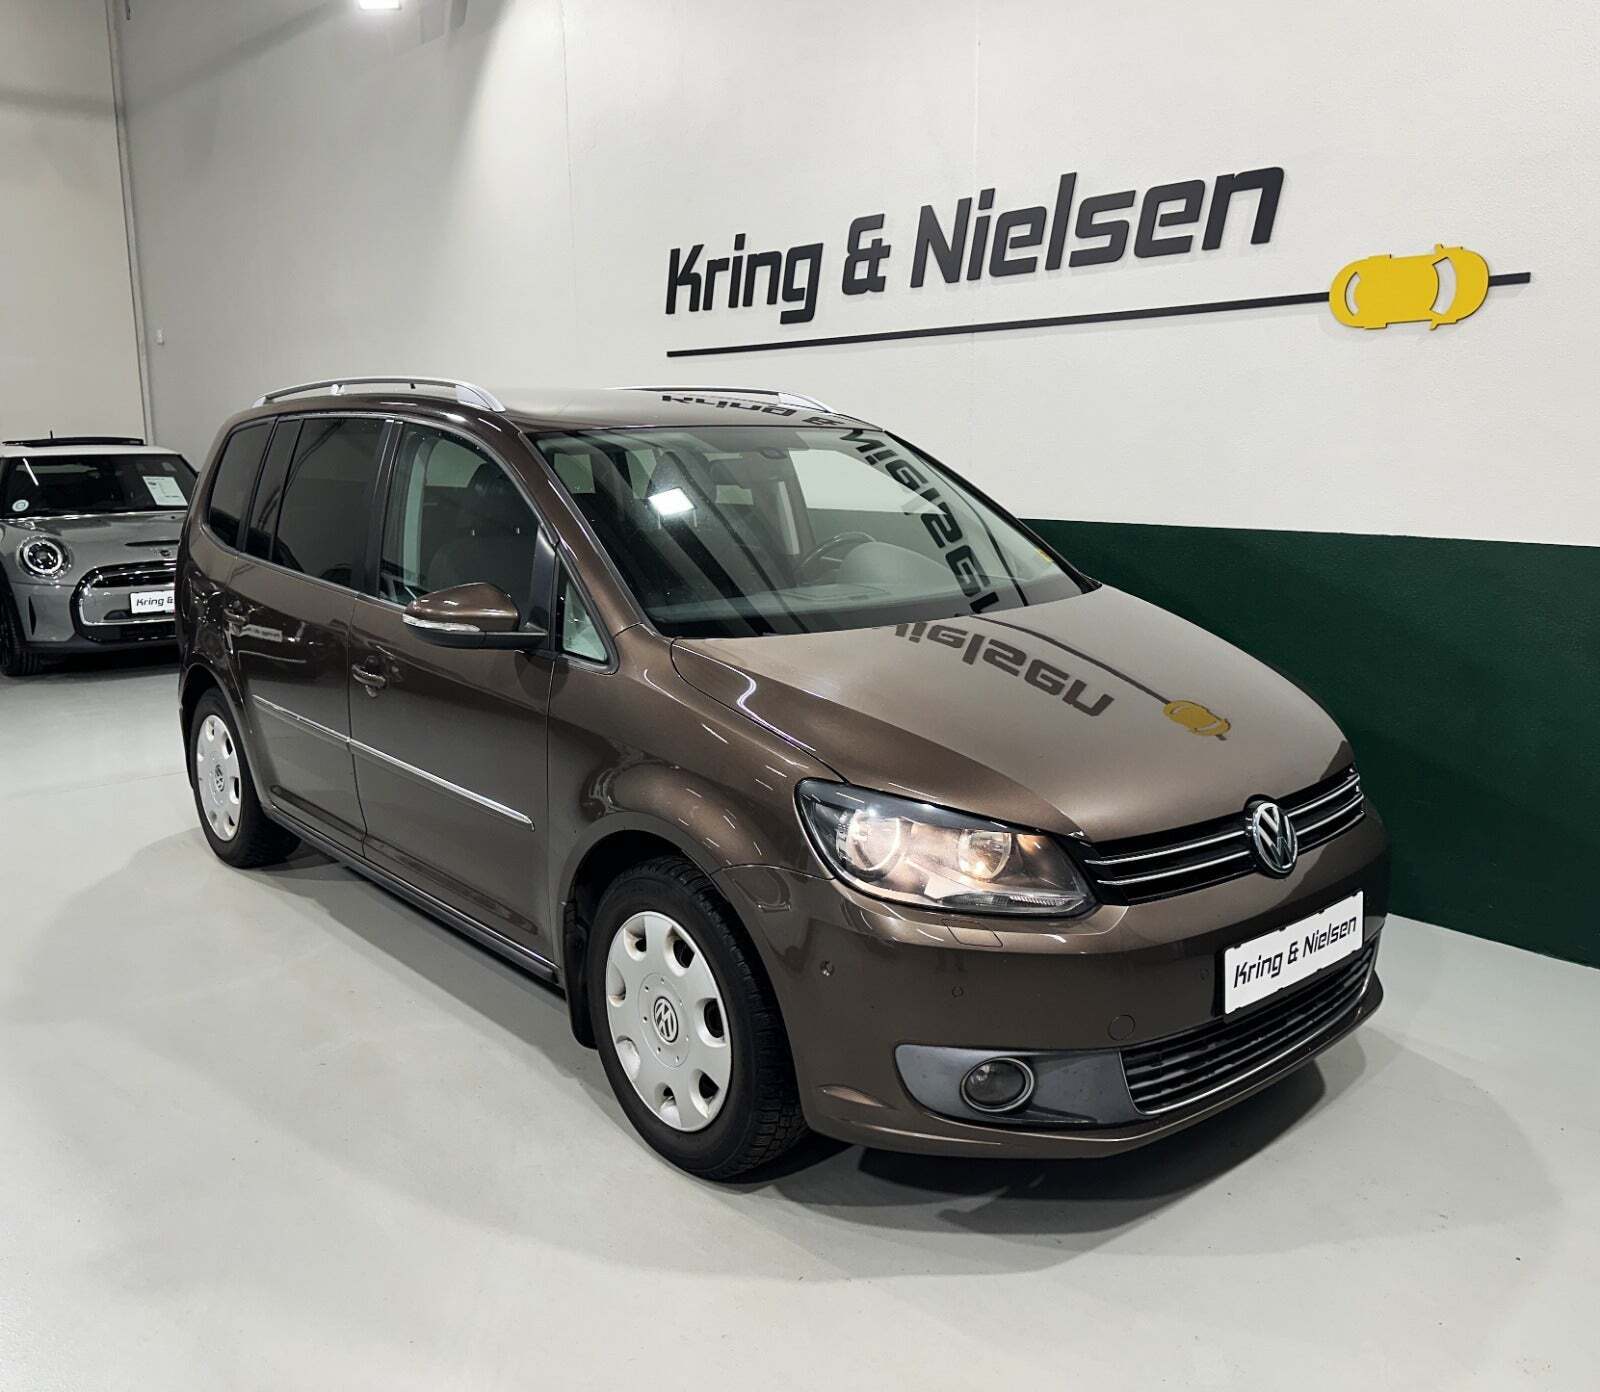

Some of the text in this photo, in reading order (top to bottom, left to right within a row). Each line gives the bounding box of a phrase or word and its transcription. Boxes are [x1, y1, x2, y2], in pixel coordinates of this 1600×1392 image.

[665, 166, 1284, 324] Kring & Nielsen
[136, 597, 165, 607] Kring
[1252, 802, 1298, 874] VW
[1233, 916, 1357, 989] Kring & Nielsen
